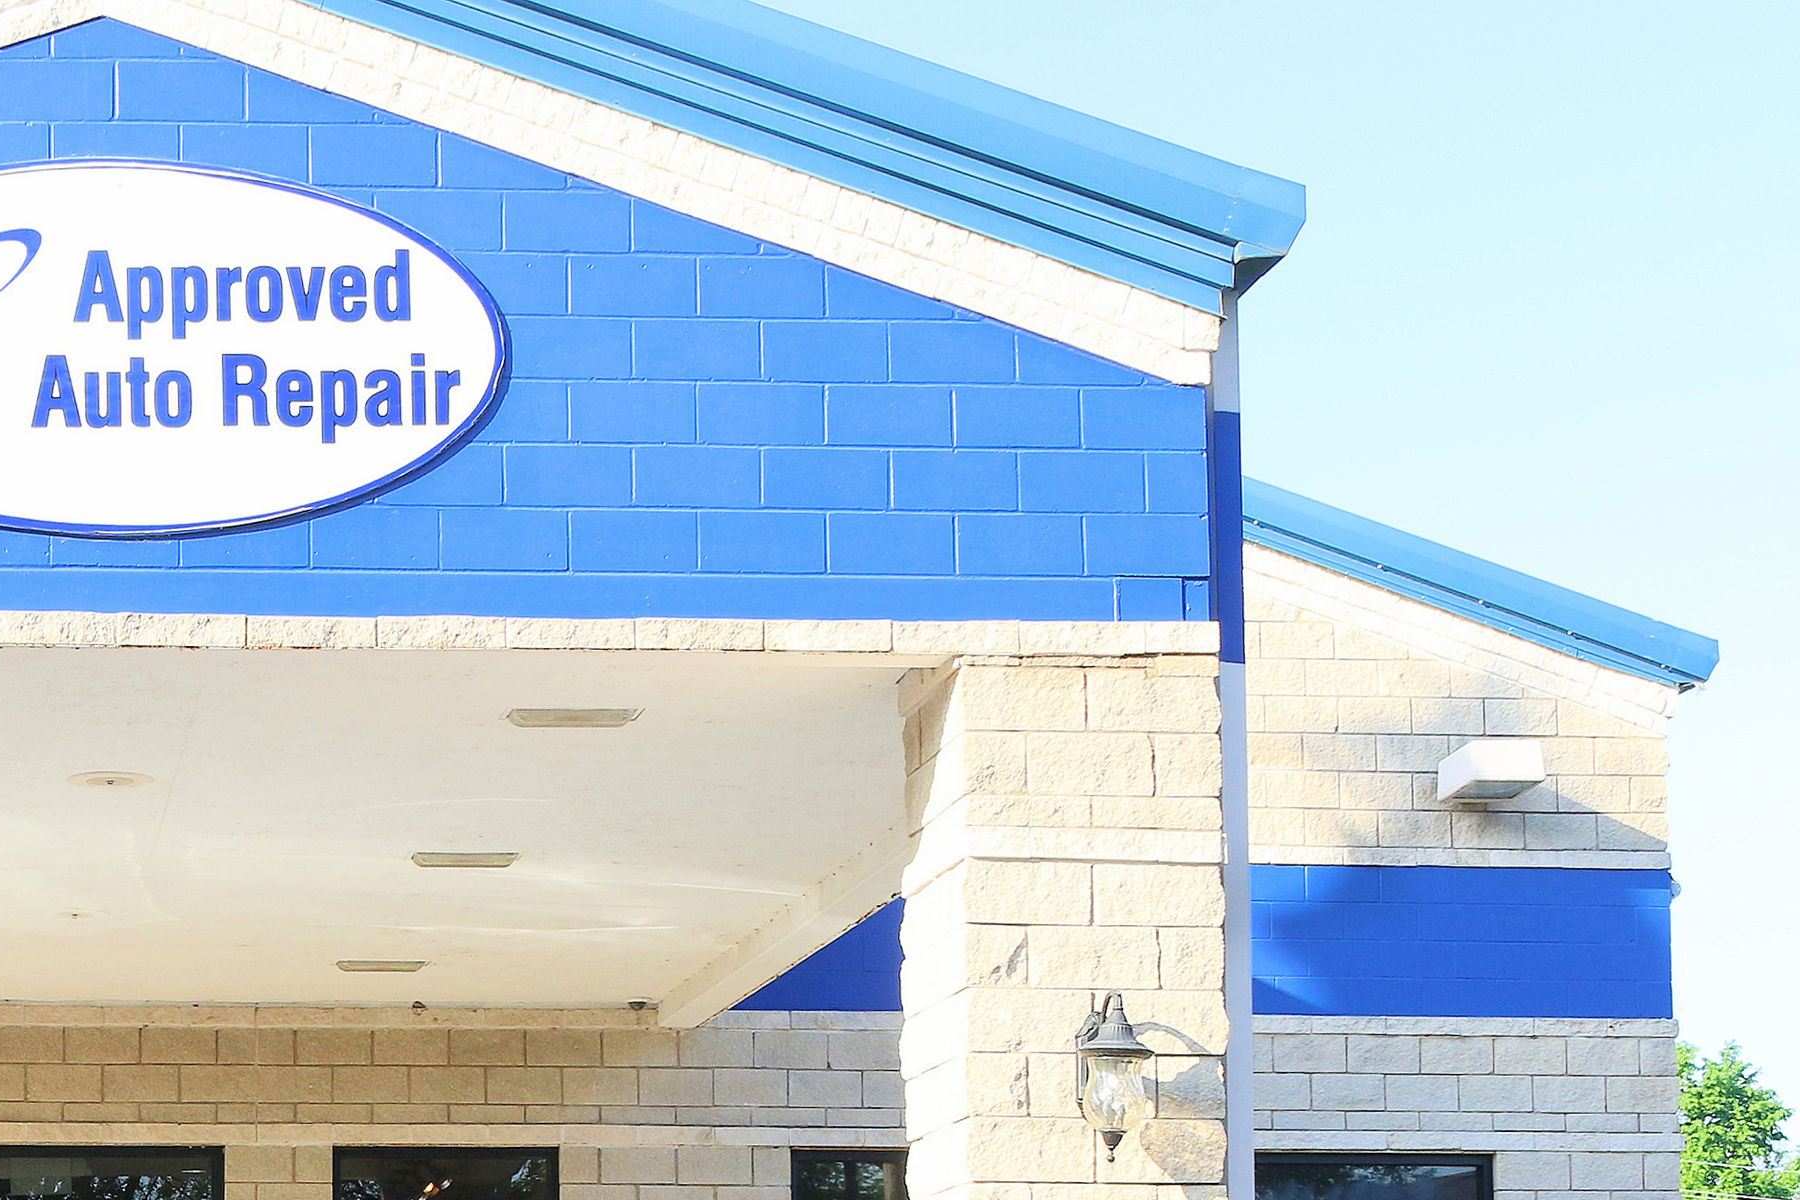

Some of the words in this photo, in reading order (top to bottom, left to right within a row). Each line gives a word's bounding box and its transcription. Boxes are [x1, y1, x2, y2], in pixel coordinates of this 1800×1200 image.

[73, 249, 412, 340] Approved
[31, 354, 193, 428] Auto
[221, 352, 461, 443] Repair
